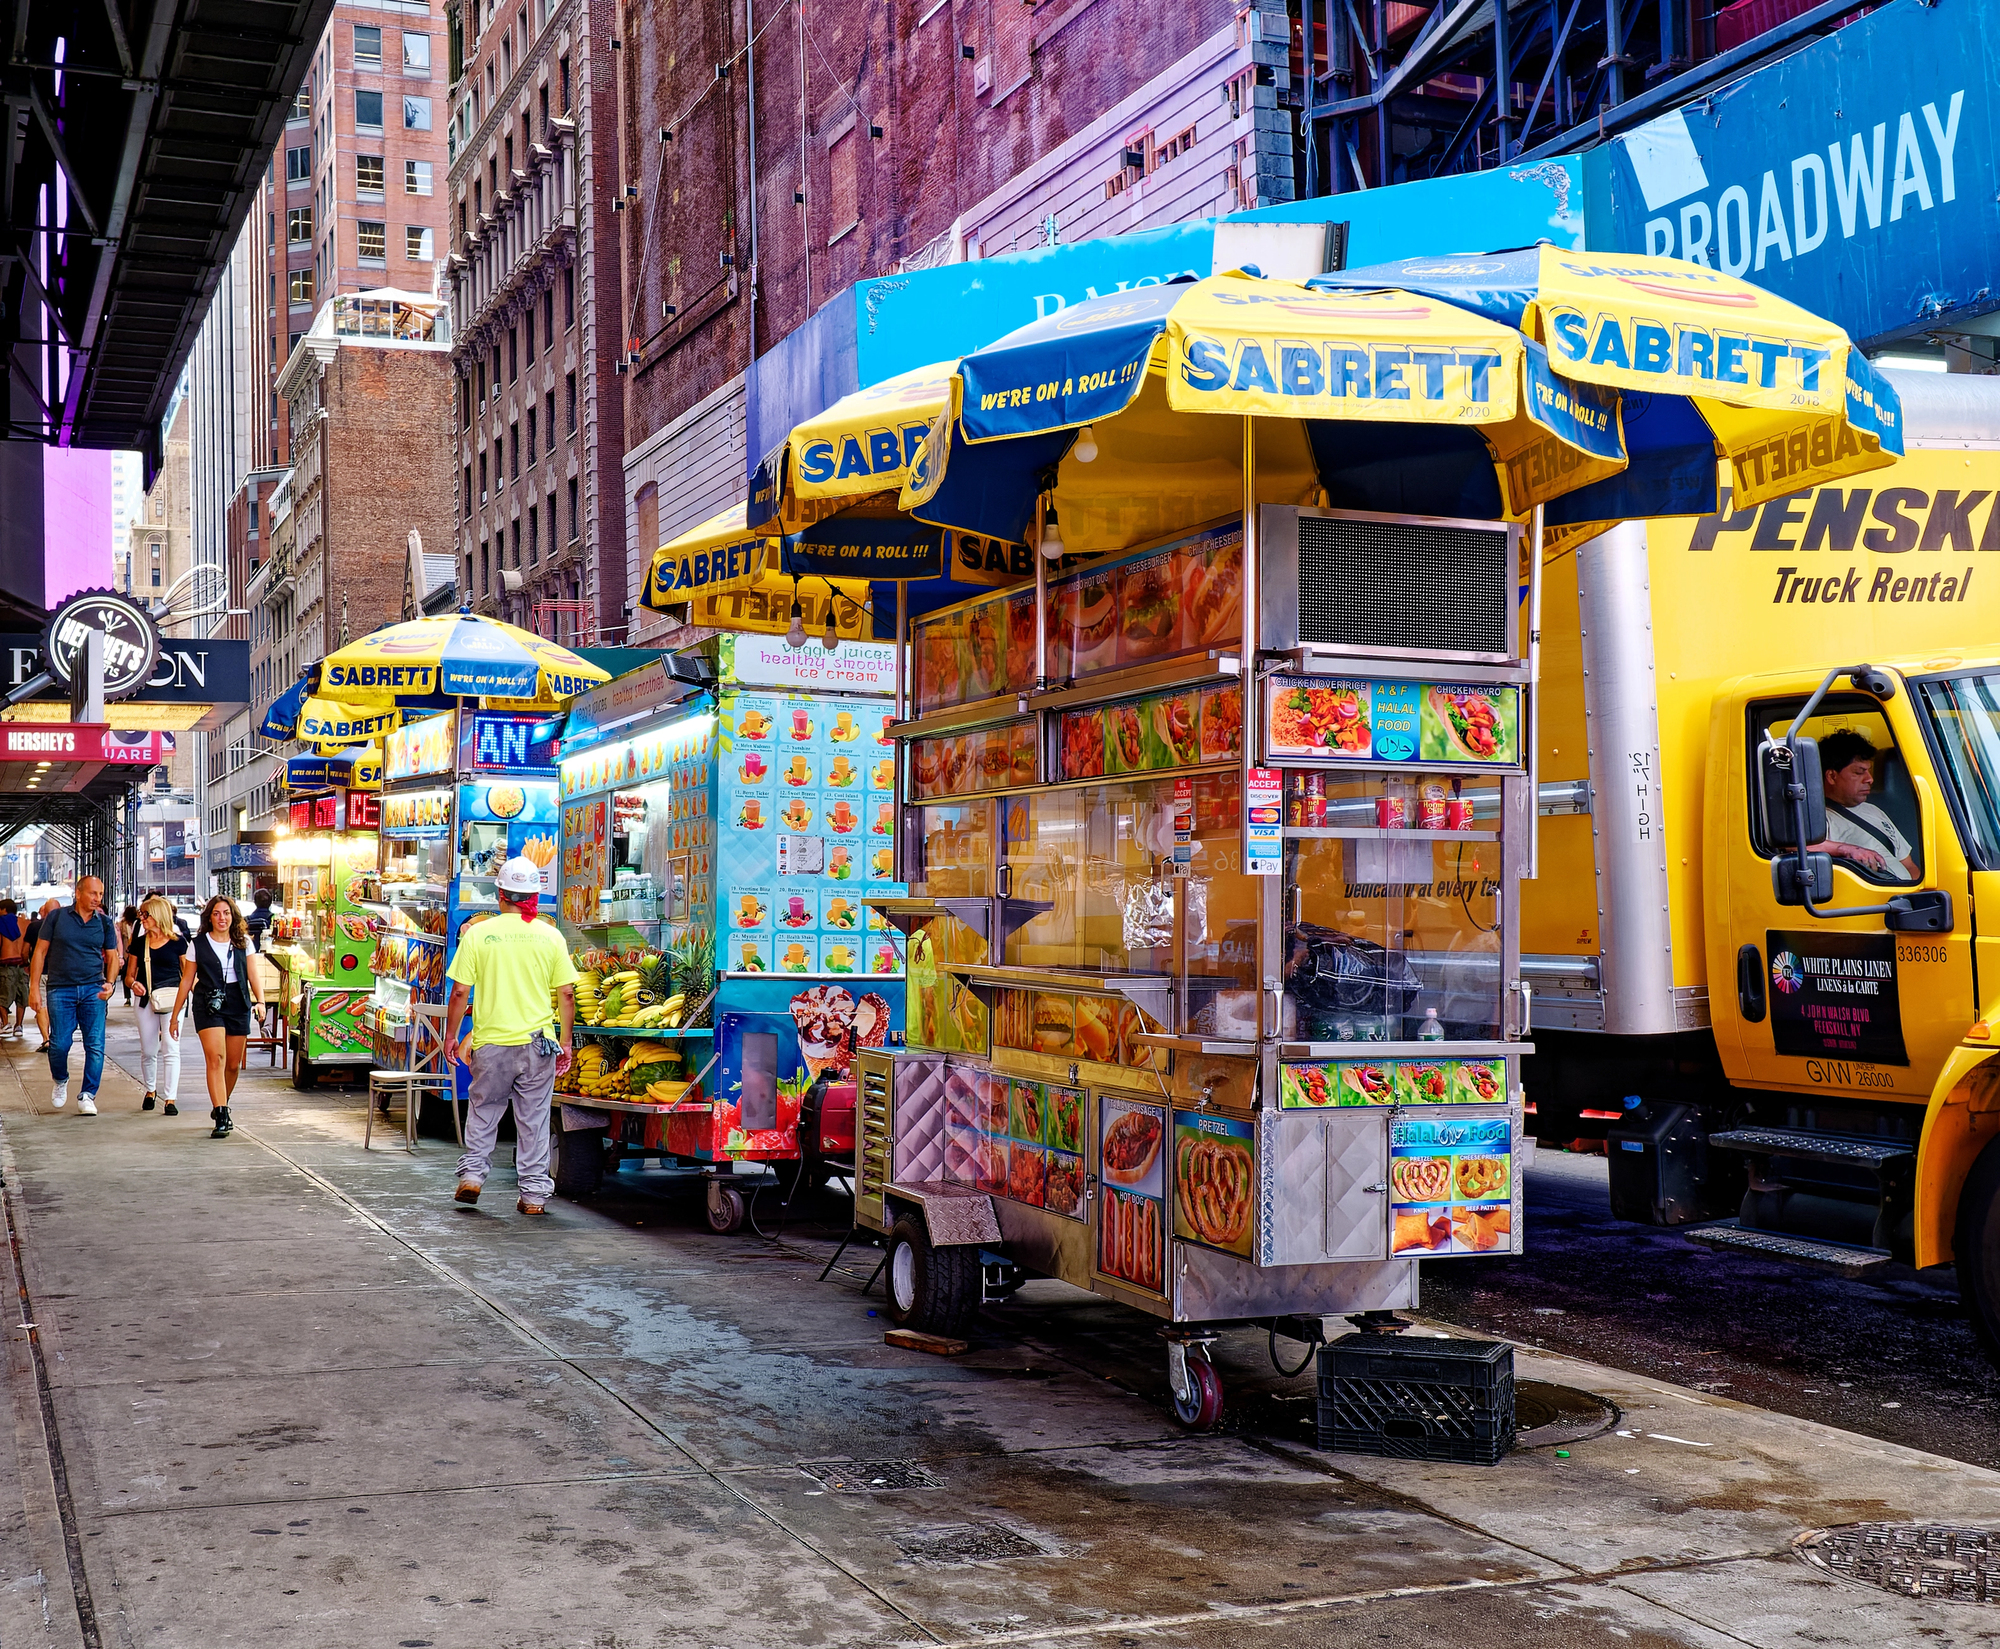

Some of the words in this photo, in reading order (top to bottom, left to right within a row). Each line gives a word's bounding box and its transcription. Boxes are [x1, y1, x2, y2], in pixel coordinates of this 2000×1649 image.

[1549, 305, 1831, 392] SABRETT
[1182, 333, 1502, 403] SABRETT
[981, 386, 1032, 411] WE'RE
[1036, 381, 1059, 402] ON
[1062, 378, 1073, 396] A
[1079, 369, 1116, 395] ROLL
[1120, 361, 1139, 384] !!!
[1790, 391, 1821, 406] 2018
[1458, 406, 1490, 418] 2020
[793, 541, 836, 557] WE'RE
[840, 545, 860, 558] ON
[862, 546, 872, 558] A
[876, 545, 909, 559] ROLL
[913, 545, 930, 558] !!!
[1125, 552, 1172, 576] CHEESEBURGER
[1773, 566, 1863, 604] Truck
[1867, 566, 1974, 603] Rental
[782, 644, 836, 658] veggie
[842, 645, 892, 660] juices
[760, 651, 825, 670] healthy
[833, 659, 896, 672] smooth
[328, 664, 433, 686] SABRETT
[450, 673, 473, 683] WE'RE
[476, 676, 487, 684] ON
[488, 676, 495, 684] A
[496, 676, 516, 686] ROLL
[795, 665, 819, 678] ice
[826, 669, 878, 682] cream
[1275, 677, 1316, 688] CHICKEN
[1318, 679, 1344, 690] OVER
[1346, 680, 1367, 691] RICE
[1376, 685, 1385, 696] A
[1389, 685, 1398, 696] &
[1400, 686, 1409, 696] F
[1436, 685, 1475, 696] CHICKEN
[1476, 686, 1501, 697] GYRO
[1376, 702, 1416, 714] HALAL
[303, 713, 396, 737] SABRETT
[1376, 719, 1411, 732] FOOD
[8, 731, 75, 752] HERSHEY'S
[1379, 737, 1414, 755] حلال
[1257, 770, 1271, 779] WE
[1179, 780, 1186, 788] WE
[1249, 780, 1281, 788] ACCEPT
[1174, 789, 1192, 797] ACCEPT
[1251, 812, 1279, 820] MasterCard
[1180, 863, 1190, 876] Pay
[1260, 859, 1278, 873] Pay
[1418, 881, 1434, 898] at
[1437, 880, 1478, 902] every
[1898, 946, 1948, 963] 336306
[1802, 957, 1831, 975] WHITE
[1832, 958, 1863, 977] PLAINS
[1864, 960, 1892, 978] LINEN
[1817, 978, 1842, 992] LINENS
[1842, 981, 1847, 993] à
[1848, 982, 1855, 994] la
[1855, 980, 1879, 995] CARTE
[1801, 1004, 1805, 1017] 4
[1807, 1004, 1827, 1019] JOHN
[1827, 1006, 1851, 1021] WALSH
[1851, 1024, 1861, 1037] NY
[1806, 1060, 1852, 1085] GVW
[1853, 1063, 1877, 1071] UNDER
[1856, 1071, 1894, 1088] 26000
[1129, 1102, 1157, 1117] SAUSAGE
[1198, 1119, 1230, 1136] PRETZEL
[1395, 1124, 1436, 1143] Halal
[1469, 1123, 1506, 1140] Food
[1119, 1191, 1131, 1202] HOT
[1131, 1194, 1144, 1206] DOG
